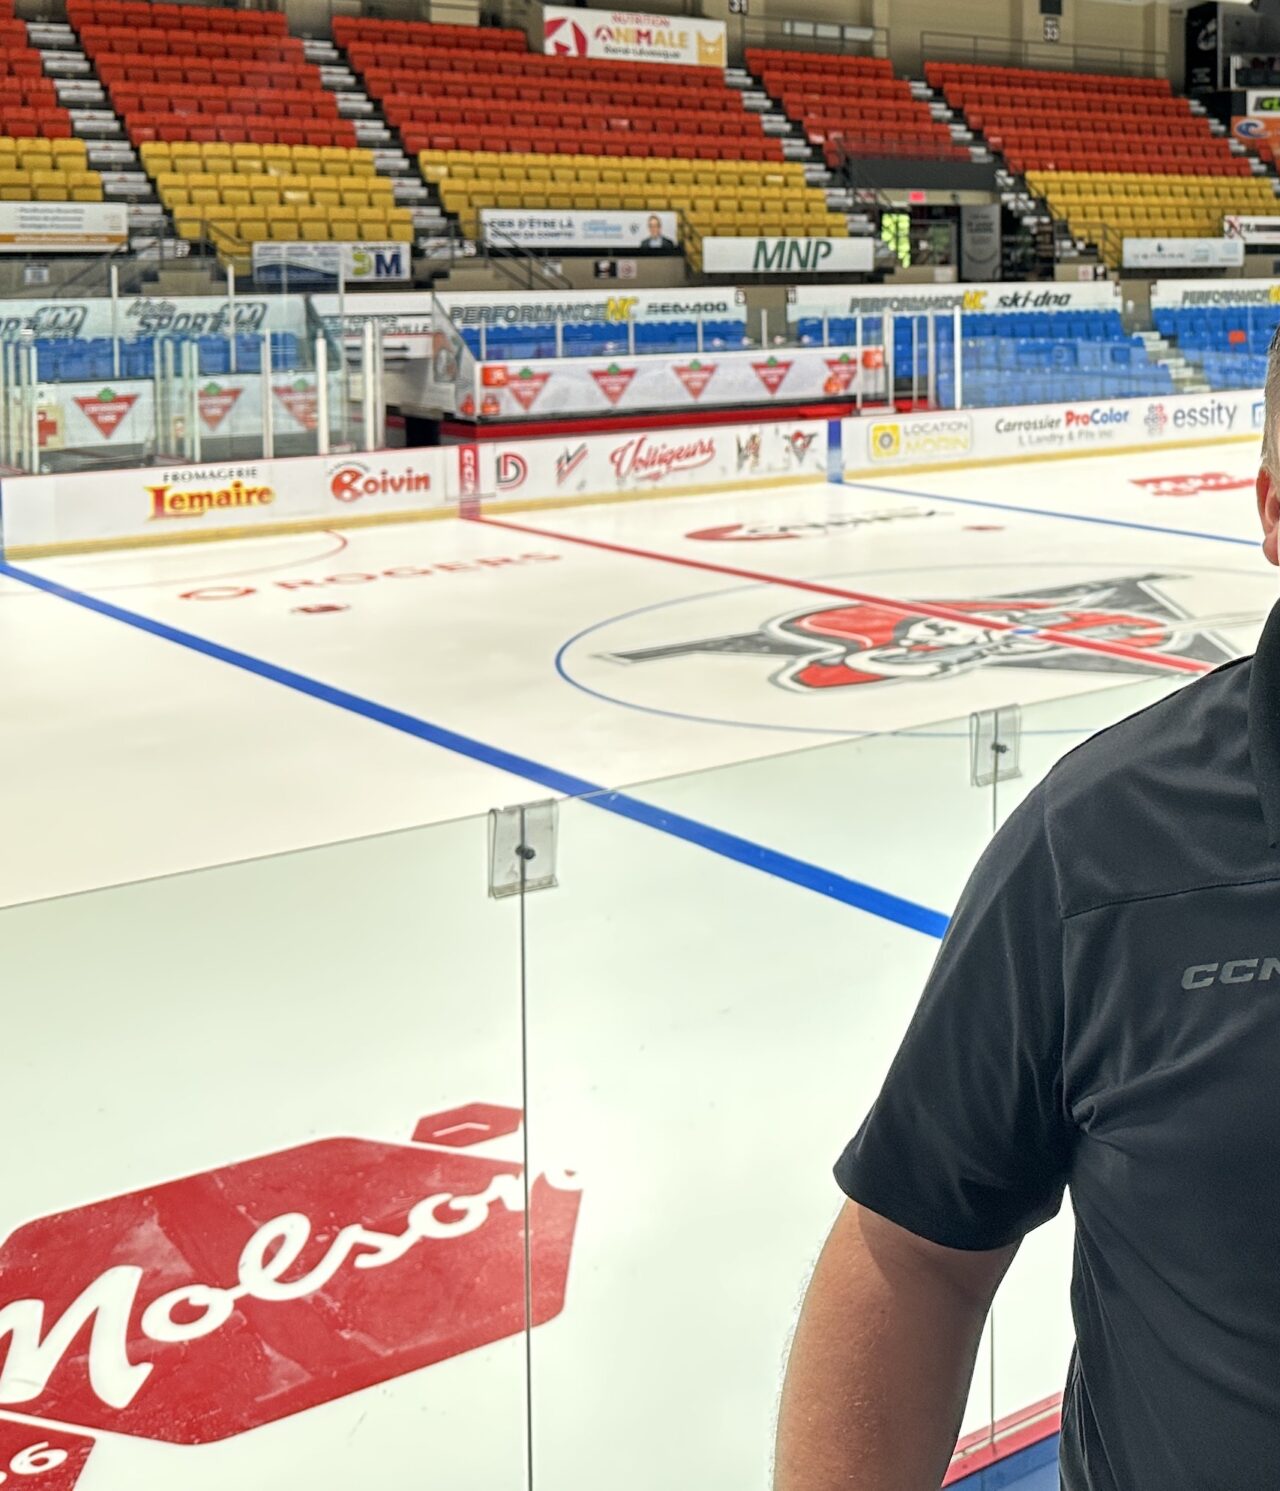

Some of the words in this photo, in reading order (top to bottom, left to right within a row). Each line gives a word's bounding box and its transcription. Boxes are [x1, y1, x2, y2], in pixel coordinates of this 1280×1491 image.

[753, 239, 831, 270] MNP
[904, 421, 968, 436] LOCATION
[995, 416, 1061, 434] Carrossier
[1065, 408, 1129, 427] ProColor
[1173, 399, 1237, 430] essity
[609, 434, 716, 481] Voltigeurs
[163, 467, 257, 483] FROMAGERIE
[145, 480, 275, 521] Lemaire
[273, 552, 562, 589] ROGERS
